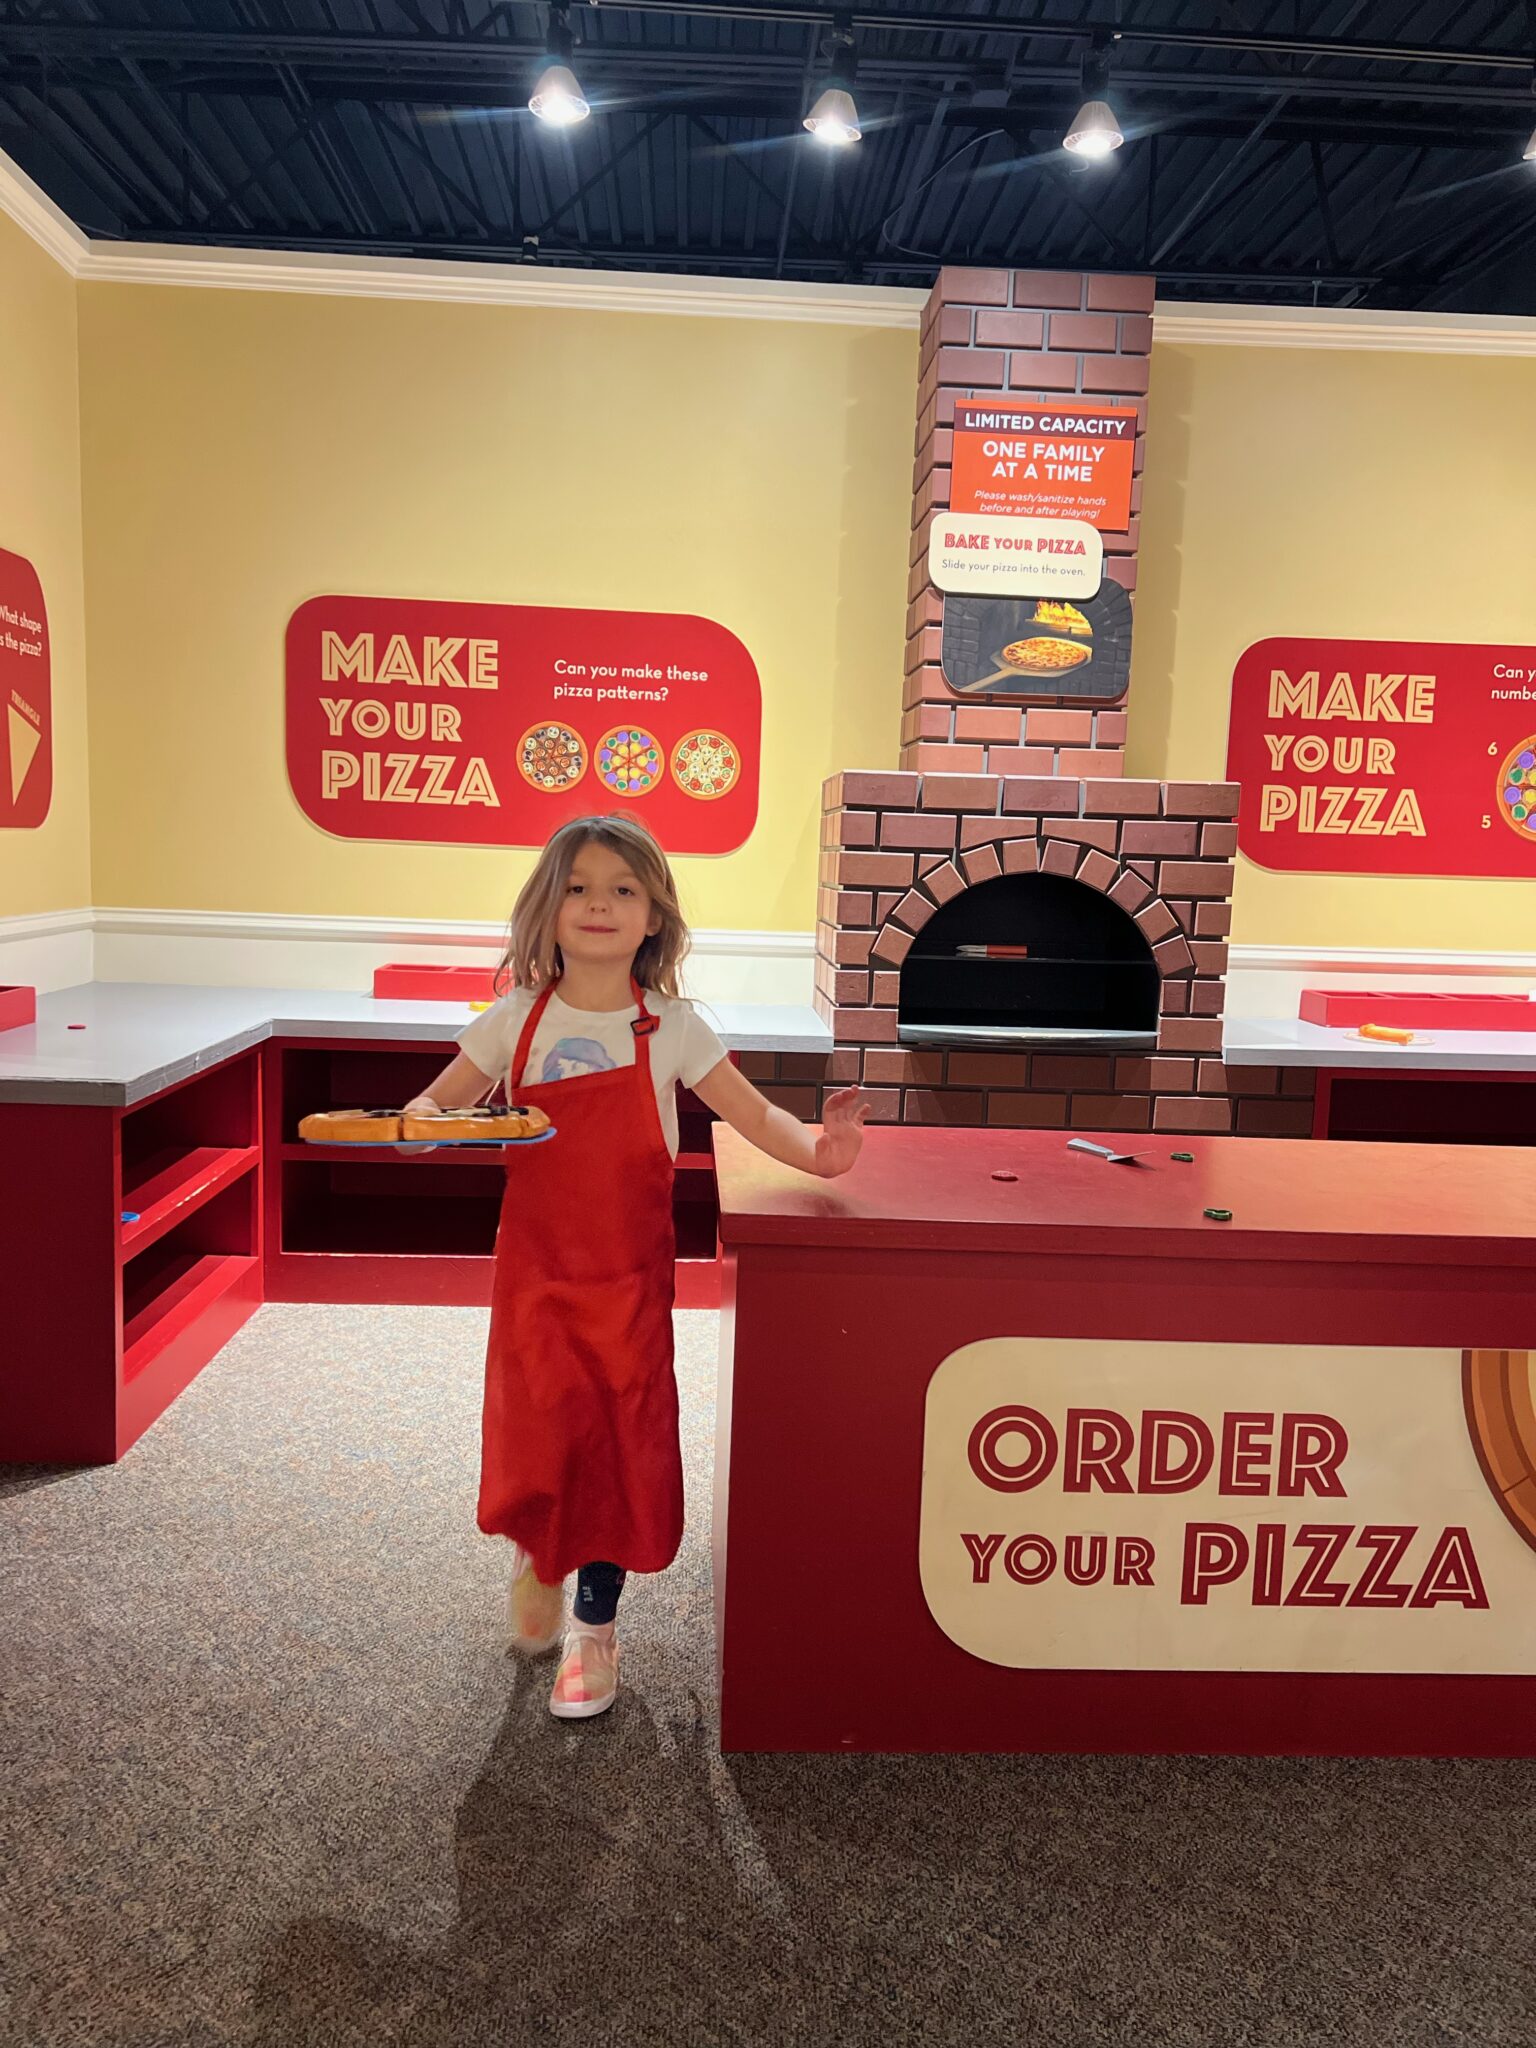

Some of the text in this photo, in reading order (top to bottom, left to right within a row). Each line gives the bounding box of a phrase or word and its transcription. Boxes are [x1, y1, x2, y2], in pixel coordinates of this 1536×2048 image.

[965, 413, 1126, 435] LIMITED CAPACITY
[983, 441, 1105, 462] ONE FAMILY
[992, 462, 1092, 482] AT A TIME
[974, 490, 1106, 506] Please wash/sanitize hands
[980, 503, 1100, 519] before and after playing!
[944, 533, 1086, 555] BAKE YOUR PIZZA
[942, 558, 1085, 577] Slide your pizza into the oven.
[20, 611, 41, 635] shape
[5, 632, 18, 651] the
[321, 630, 498, 689] MAKE
[554, 659, 709, 682] Can you make these
[1494, 664, 1523, 678] Can
[553, 683, 669, 703] pizza patterns?
[1268, 670, 1436, 723] MAKE
[319, 698, 462, 742] YOUR
[1264, 734, 1395, 775] YOUR
[1488, 742, 1497, 755] 6
[321, 750, 501, 807] PIZZA
[1259, 784, 1427, 836] PIZZA
[1481, 815, 1491, 829] 5
[967, 1404, 1349, 1498] ORDER
[960, 1522, 1490, 1610] YOUR PIZZA
